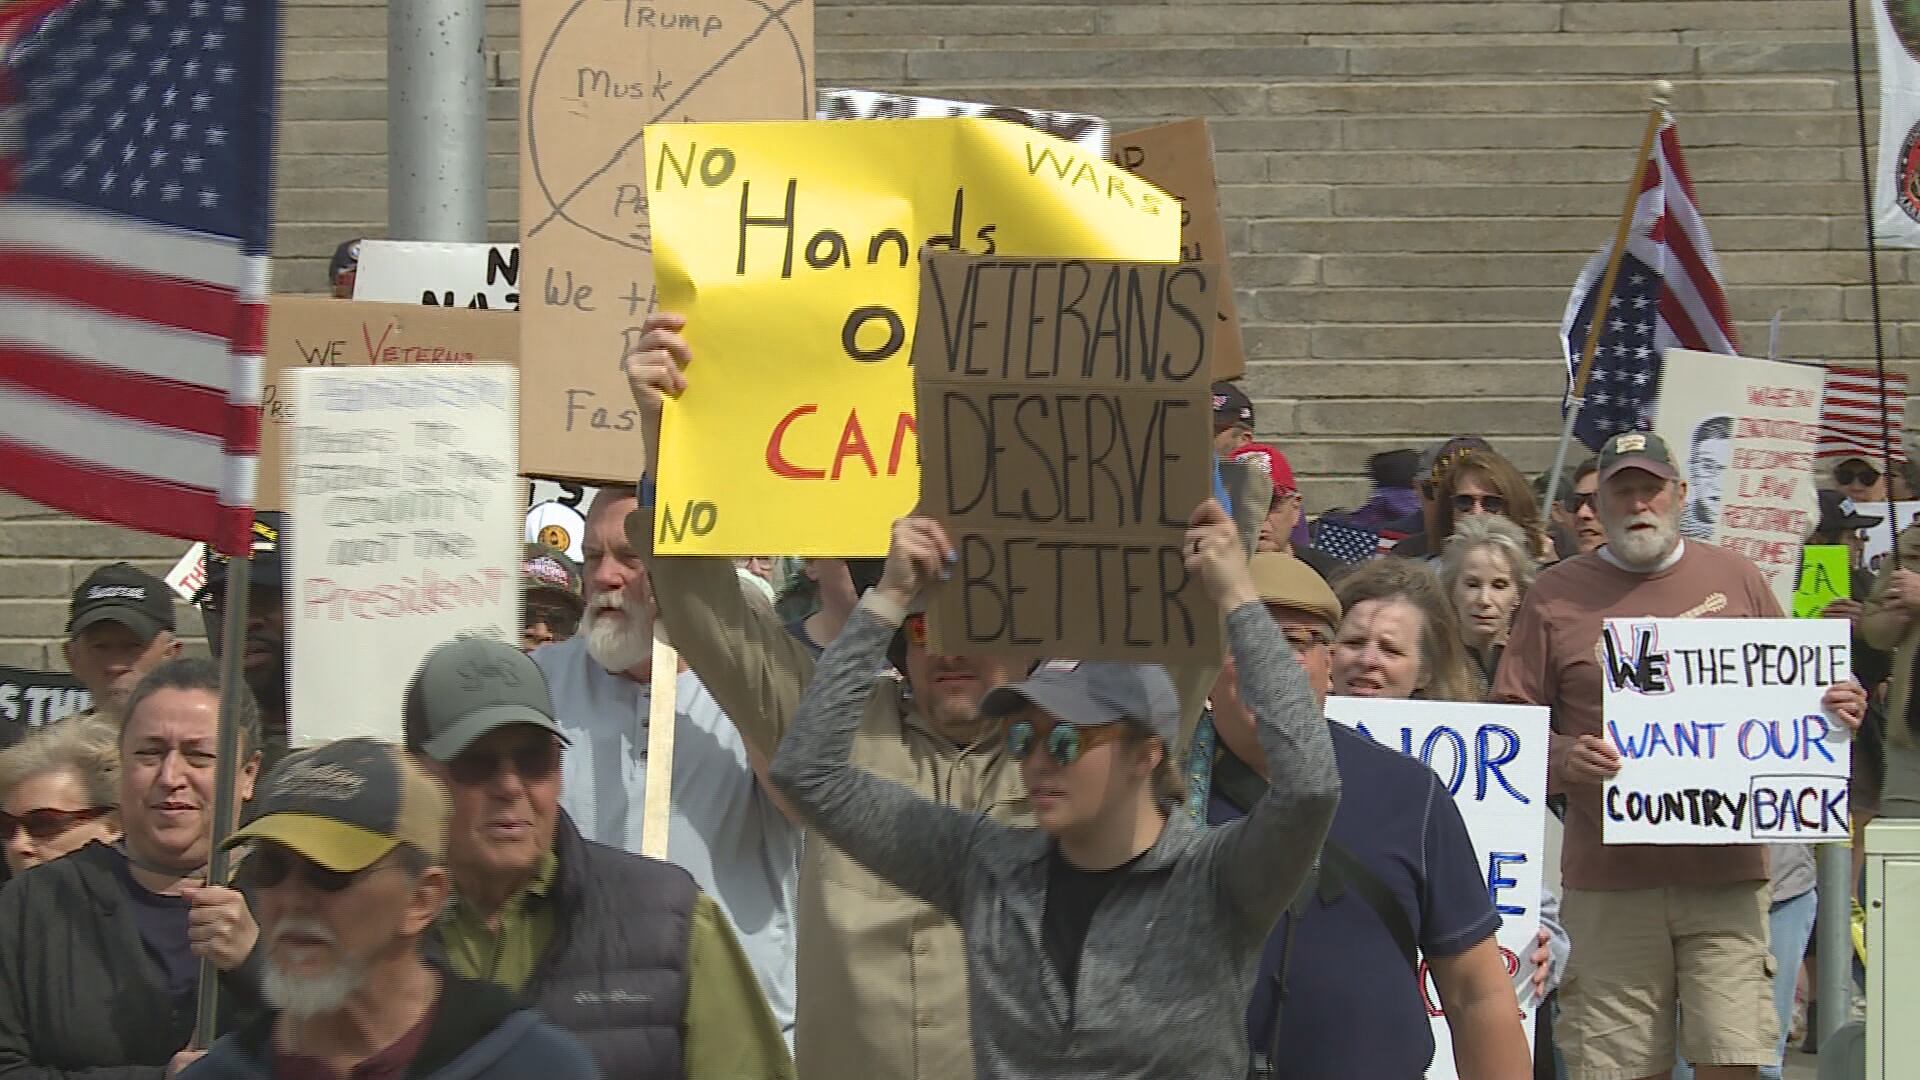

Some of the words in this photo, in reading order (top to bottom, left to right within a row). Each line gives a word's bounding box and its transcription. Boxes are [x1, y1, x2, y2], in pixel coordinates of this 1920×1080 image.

[1025, 142, 1160, 216] WARS
[736, 178, 996, 279] Hands
[545, 267, 596, 311] We
[928, 260, 1206, 382] VETERANS
[296, 338, 347, 367] WE
[1747, 384, 1815, 409] WHEN
[1734, 417, 1822, 445] INJUSTICE
[943, 391, 1191, 528] DESERVE
[1732, 447, 1816, 473] BECOMES
[1737, 474, 1798, 500] LAW
[1722, 504, 1808, 537] RESISTANCE
[962, 534, 1196, 647] BETTER
[1603, 624, 1672, 694] WE
[1674, 647, 1738, 686] THE
[1742, 643, 1847, 687] PEOPLE
[1607, 719, 1727, 759] WANT
[1737, 714, 1835, 763] OUR
[1606, 785, 1748, 832] COUNTRY
[1754, 786, 1850, 833] BACK
